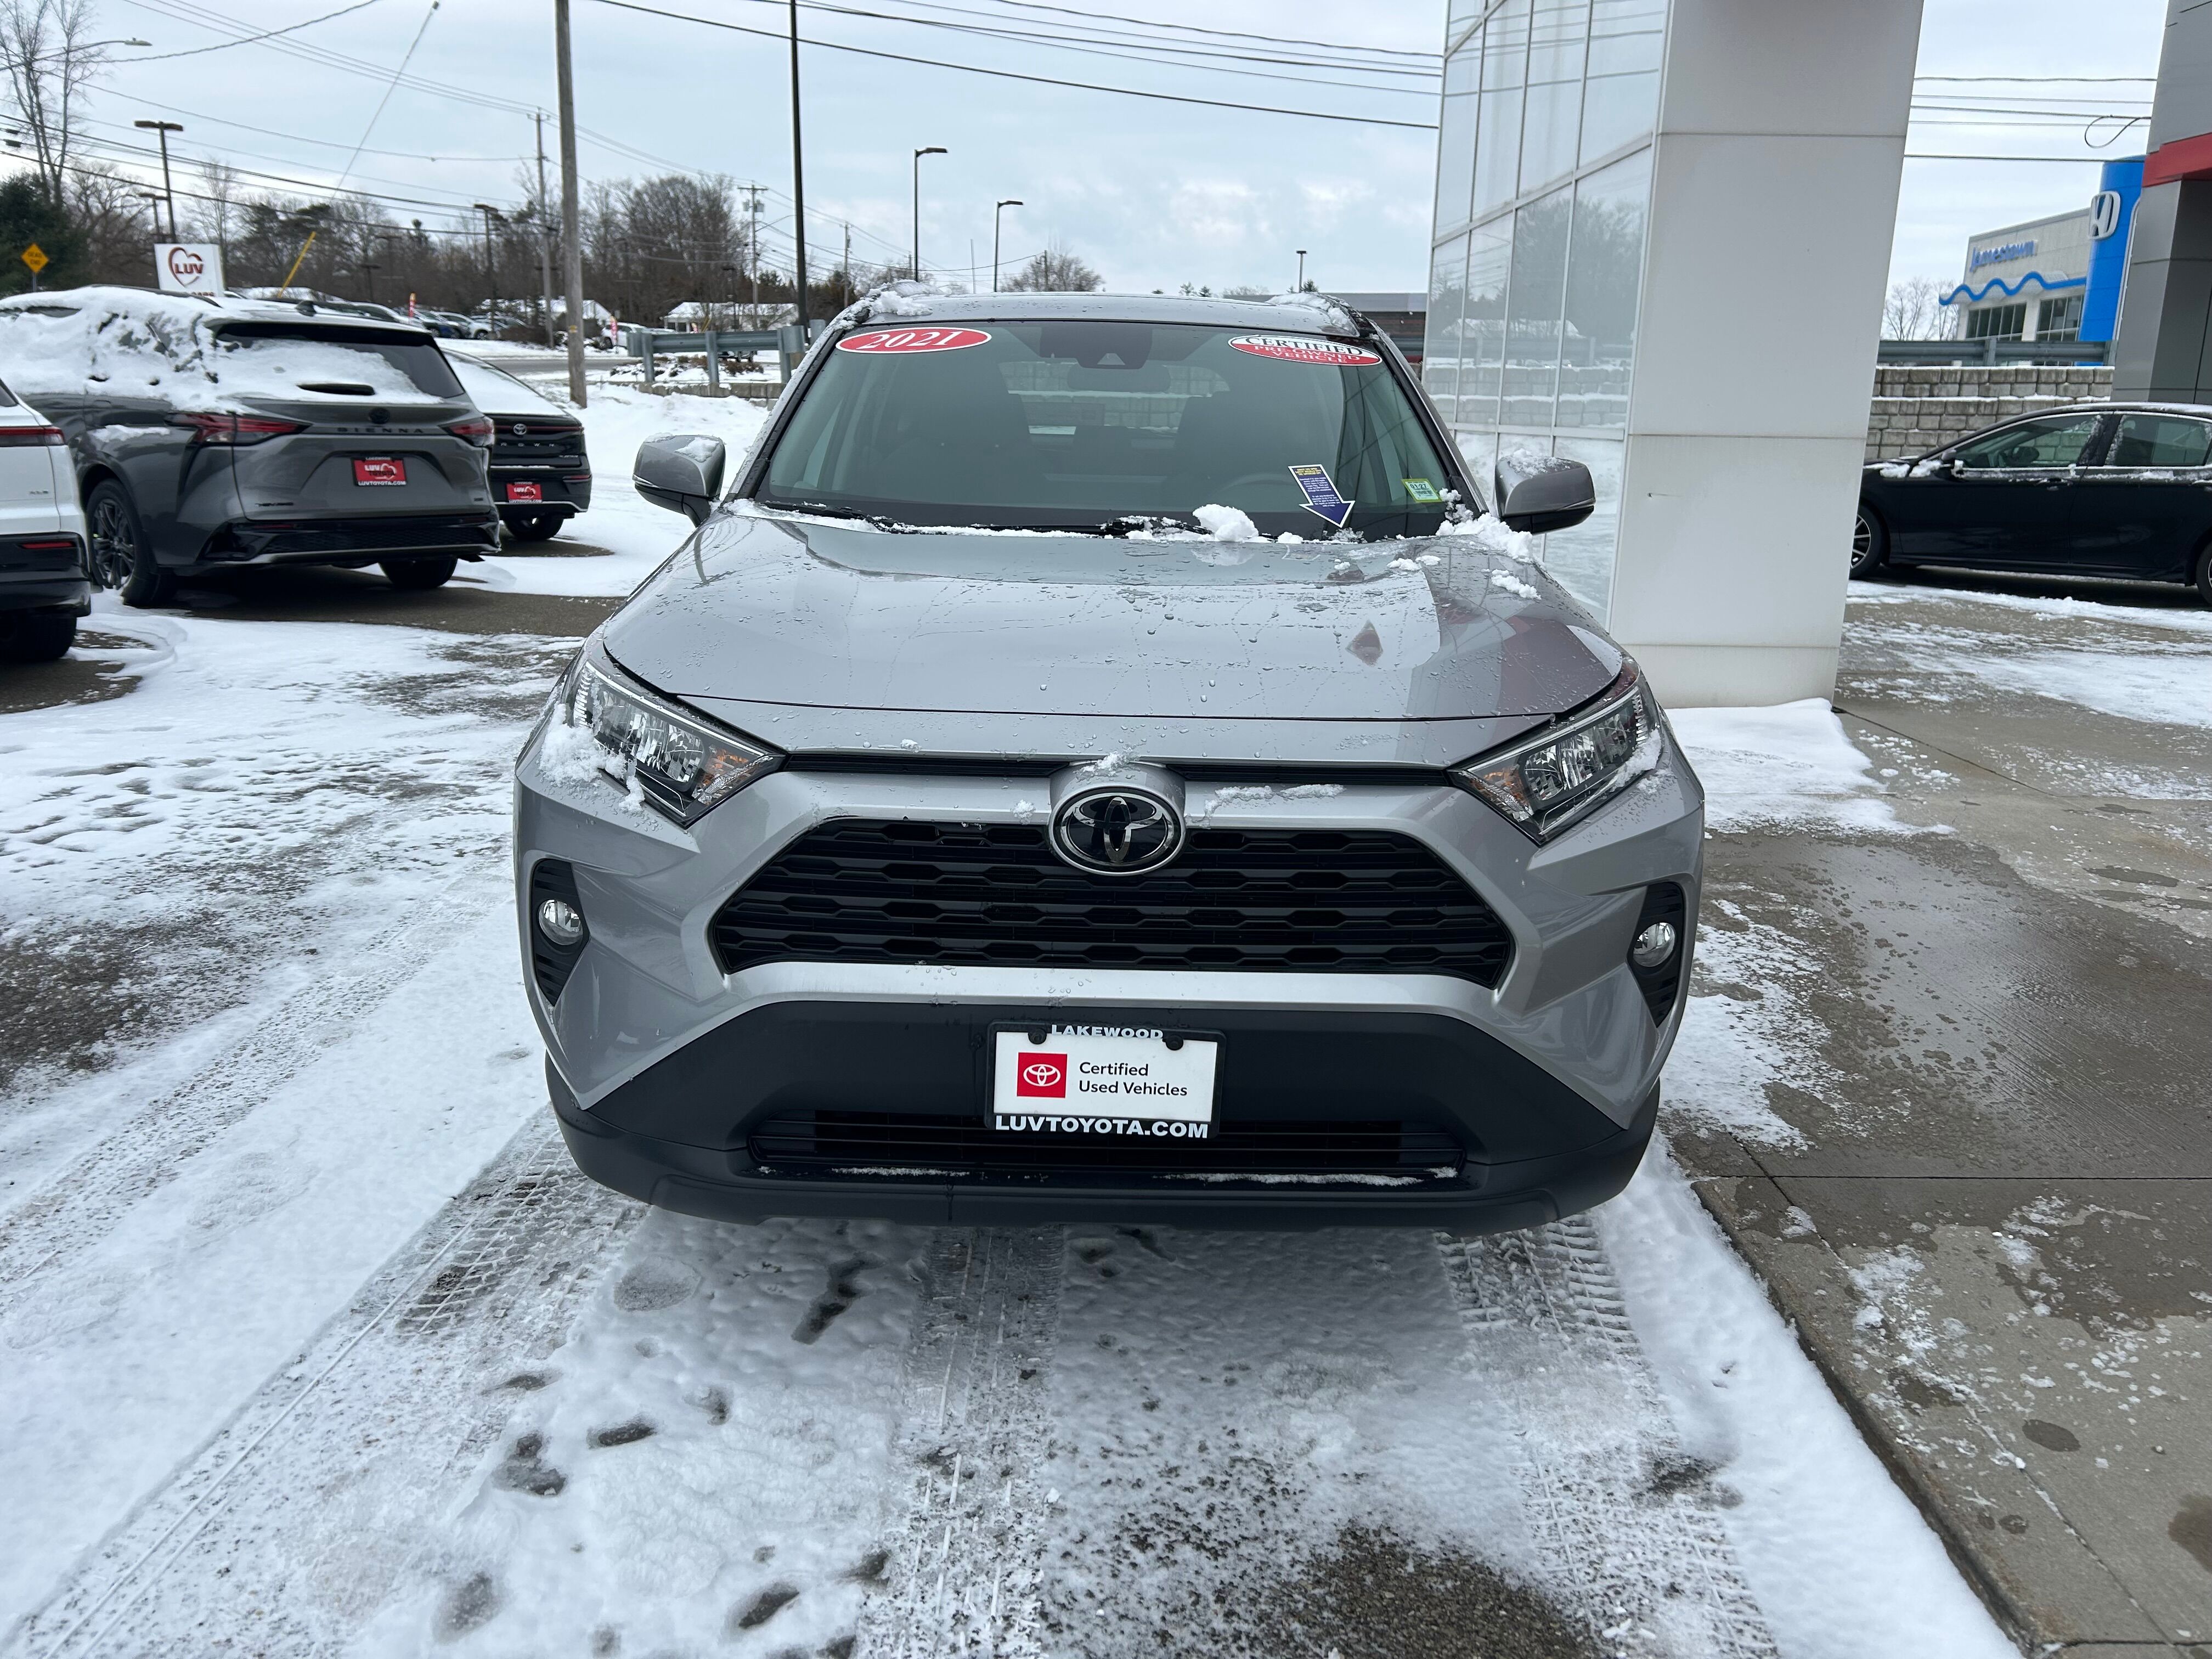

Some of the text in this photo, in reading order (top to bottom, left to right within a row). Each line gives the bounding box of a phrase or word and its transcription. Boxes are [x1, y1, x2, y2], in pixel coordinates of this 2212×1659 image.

[1969, 240, 2035, 272] Jamestown
[174, 263, 204, 274] LUV
[856, 331, 963, 349] 2021
[1245, 338, 1363, 356] CERTIFIED
[1254, 346, 1361, 360] PRE-OWNED
[1272, 351, 1347, 363] VEHICLE
[1051, 1024, 1164, 1040] LAKEWOOD
[1079, 1062, 1149, 1076] Certified
[1079, 1080, 1188, 1096] Used Vehicles
[995, 1115, 1209, 1138] LUVTOYOTA.COM
